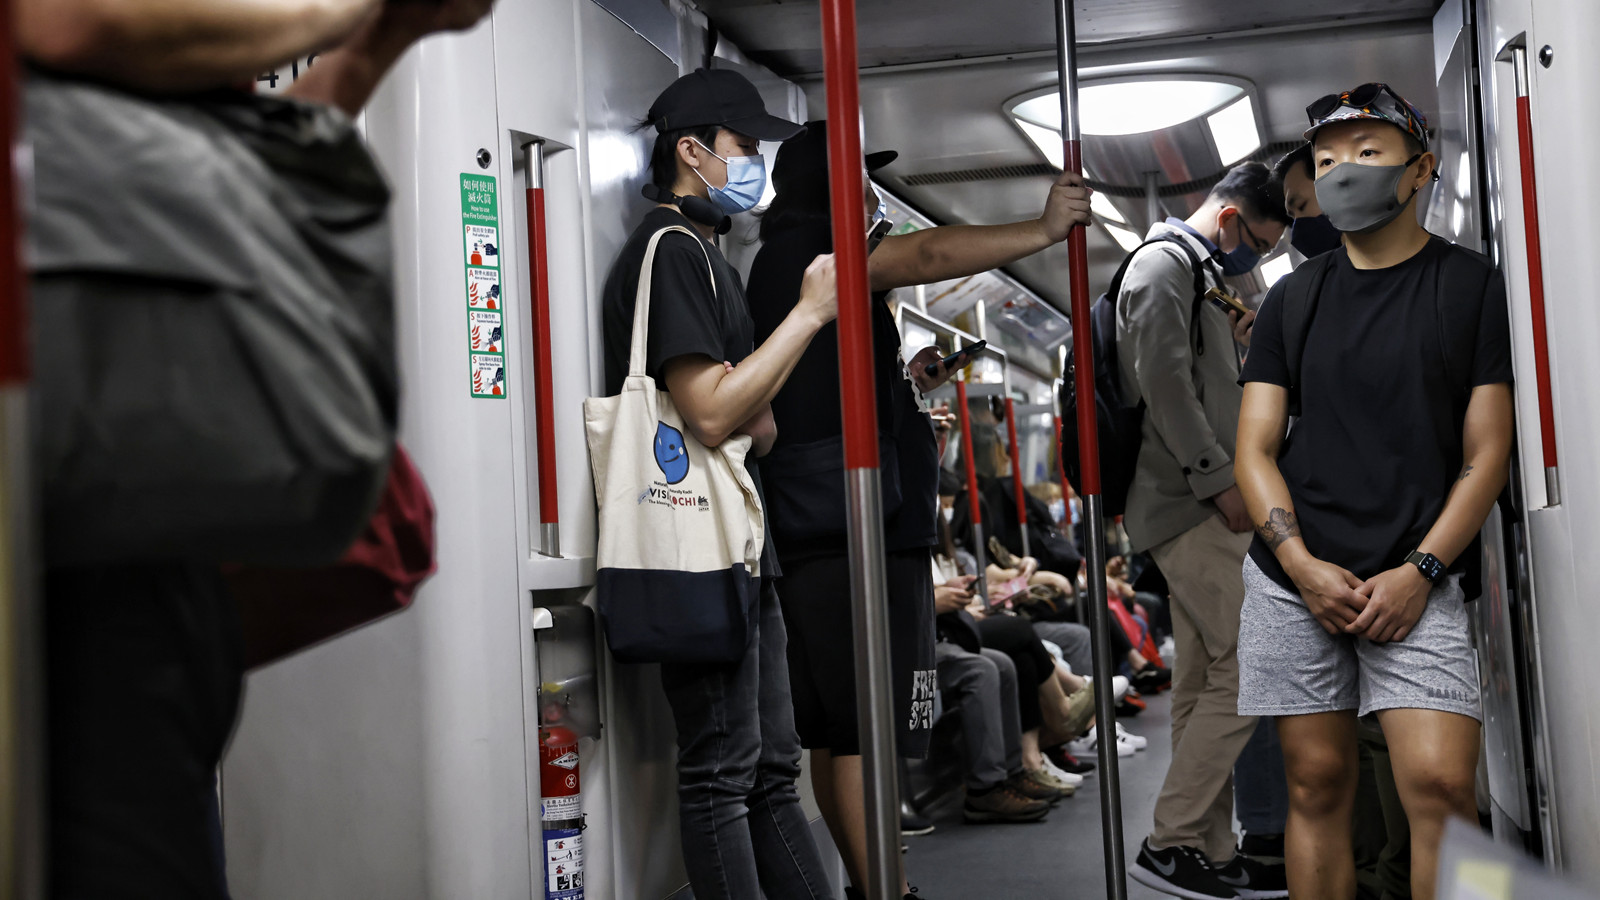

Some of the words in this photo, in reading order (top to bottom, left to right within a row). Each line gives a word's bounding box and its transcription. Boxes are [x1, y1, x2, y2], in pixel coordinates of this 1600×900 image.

[463, 179, 494, 193] 如何使用
[468, 192, 491, 205] 滅火筒
[476, 212, 497, 221] Extinguisher
[466, 226, 470, 234] P
[469, 269, 474, 277] A
[470, 312, 475, 320] S
[473, 355, 477, 364] S
